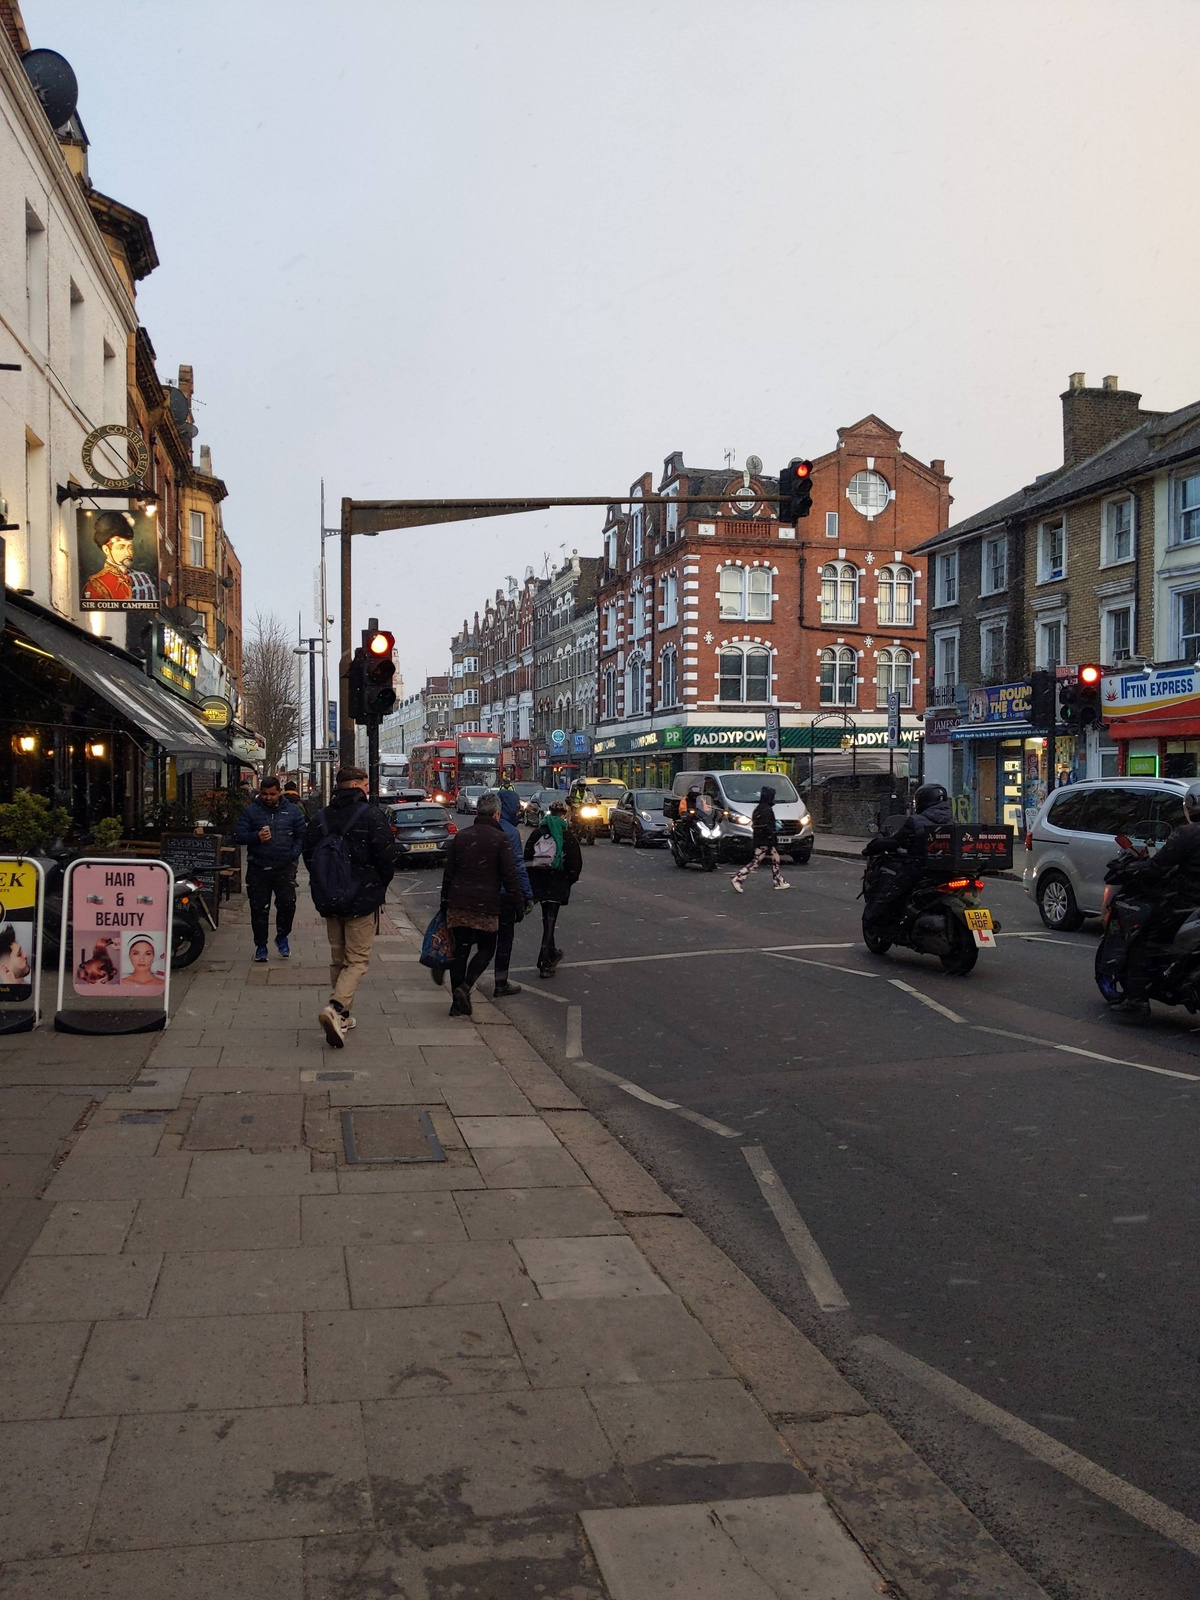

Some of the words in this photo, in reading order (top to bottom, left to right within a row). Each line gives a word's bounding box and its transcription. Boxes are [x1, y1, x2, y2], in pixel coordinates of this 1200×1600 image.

[83, 429, 101, 474] WATNEY
[106, 426, 145, 449] COMBE
[134, 454, 148, 477] REID
[104, 479, 130, 488] 1898
[82, 601, 96, 609] SIR
[97, 601, 119, 609] COLIN
[1150, 678, 1194, 697] EXPRESS
[990, 701, 1008, 713] THE
[933, 720, 954, 733] JAMES
[1135, 762, 1149, 771] cash
[105, 872, 135, 887] HAIR
[116, 892, 124, 906] &
[96, 912, 145, 926] BEAUTY
[968, 912, 988, 920] LB14
[977, 929, 989, 941] L
